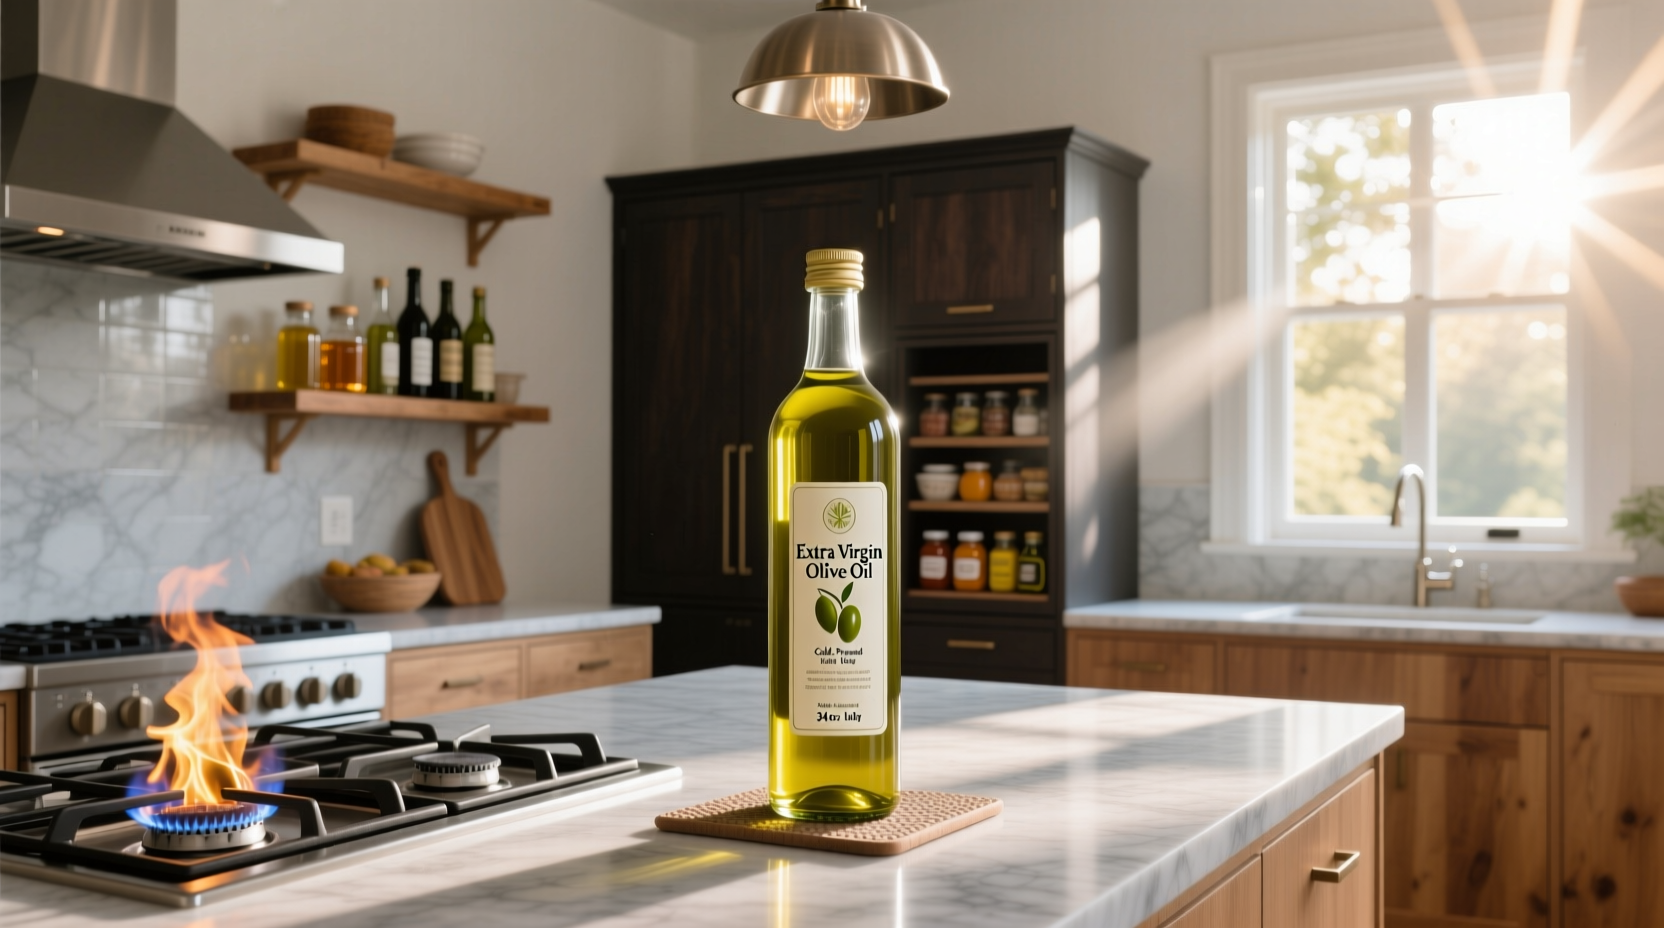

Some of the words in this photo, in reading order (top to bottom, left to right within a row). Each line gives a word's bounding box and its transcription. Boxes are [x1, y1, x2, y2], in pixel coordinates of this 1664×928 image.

[796, 543, 835, 559] Extra
[837, 543, 883, 564] Virgin
[805, 562, 847, 579] Olive
[850, 562, 873, 579] Oil
